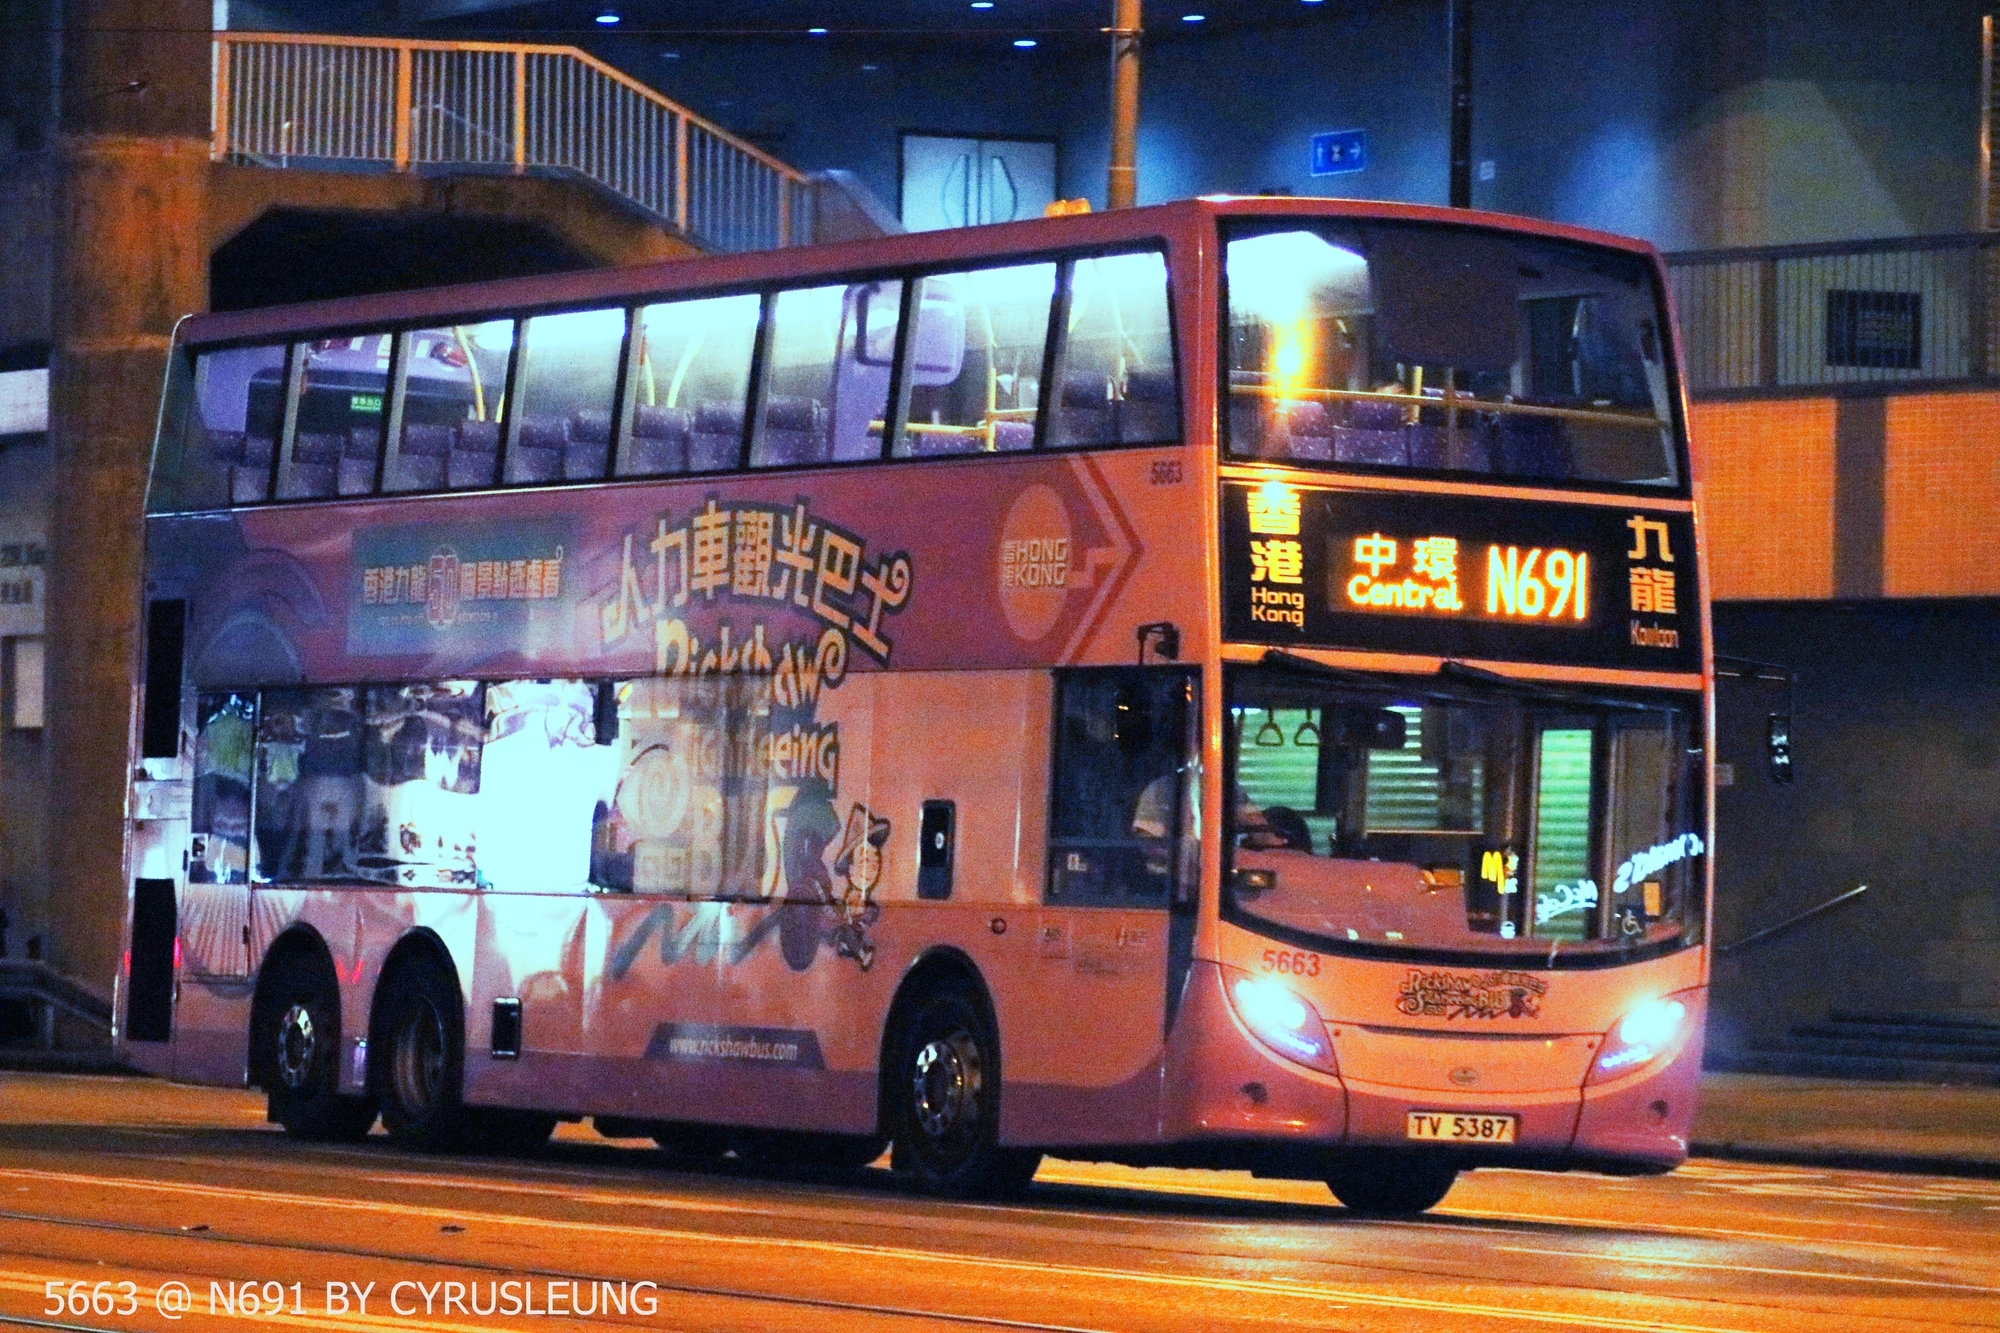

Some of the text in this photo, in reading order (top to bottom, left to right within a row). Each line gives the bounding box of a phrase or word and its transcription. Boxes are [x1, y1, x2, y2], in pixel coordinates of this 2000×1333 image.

[1016, 538, 1068, 562] HONG
[1246, 486, 1304, 585] 香港
[1354, 532, 1459, 583] 中環
[1626, 514, 1677, 615] 九龍
[602, 498, 911, 660] 人力車觀光巴士
[1015, 563, 1067, 588] KONG
[1487, 545, 1587, 619] N691
[1251, 586, 1304, 610] Hong
[1348, 574, 1462, 611] Central
[1251, 603, 1304, 627] Kong
[1261, 949, 1321, 978] 5663
[1412, 1114, 1508, 1138] TV 5387
